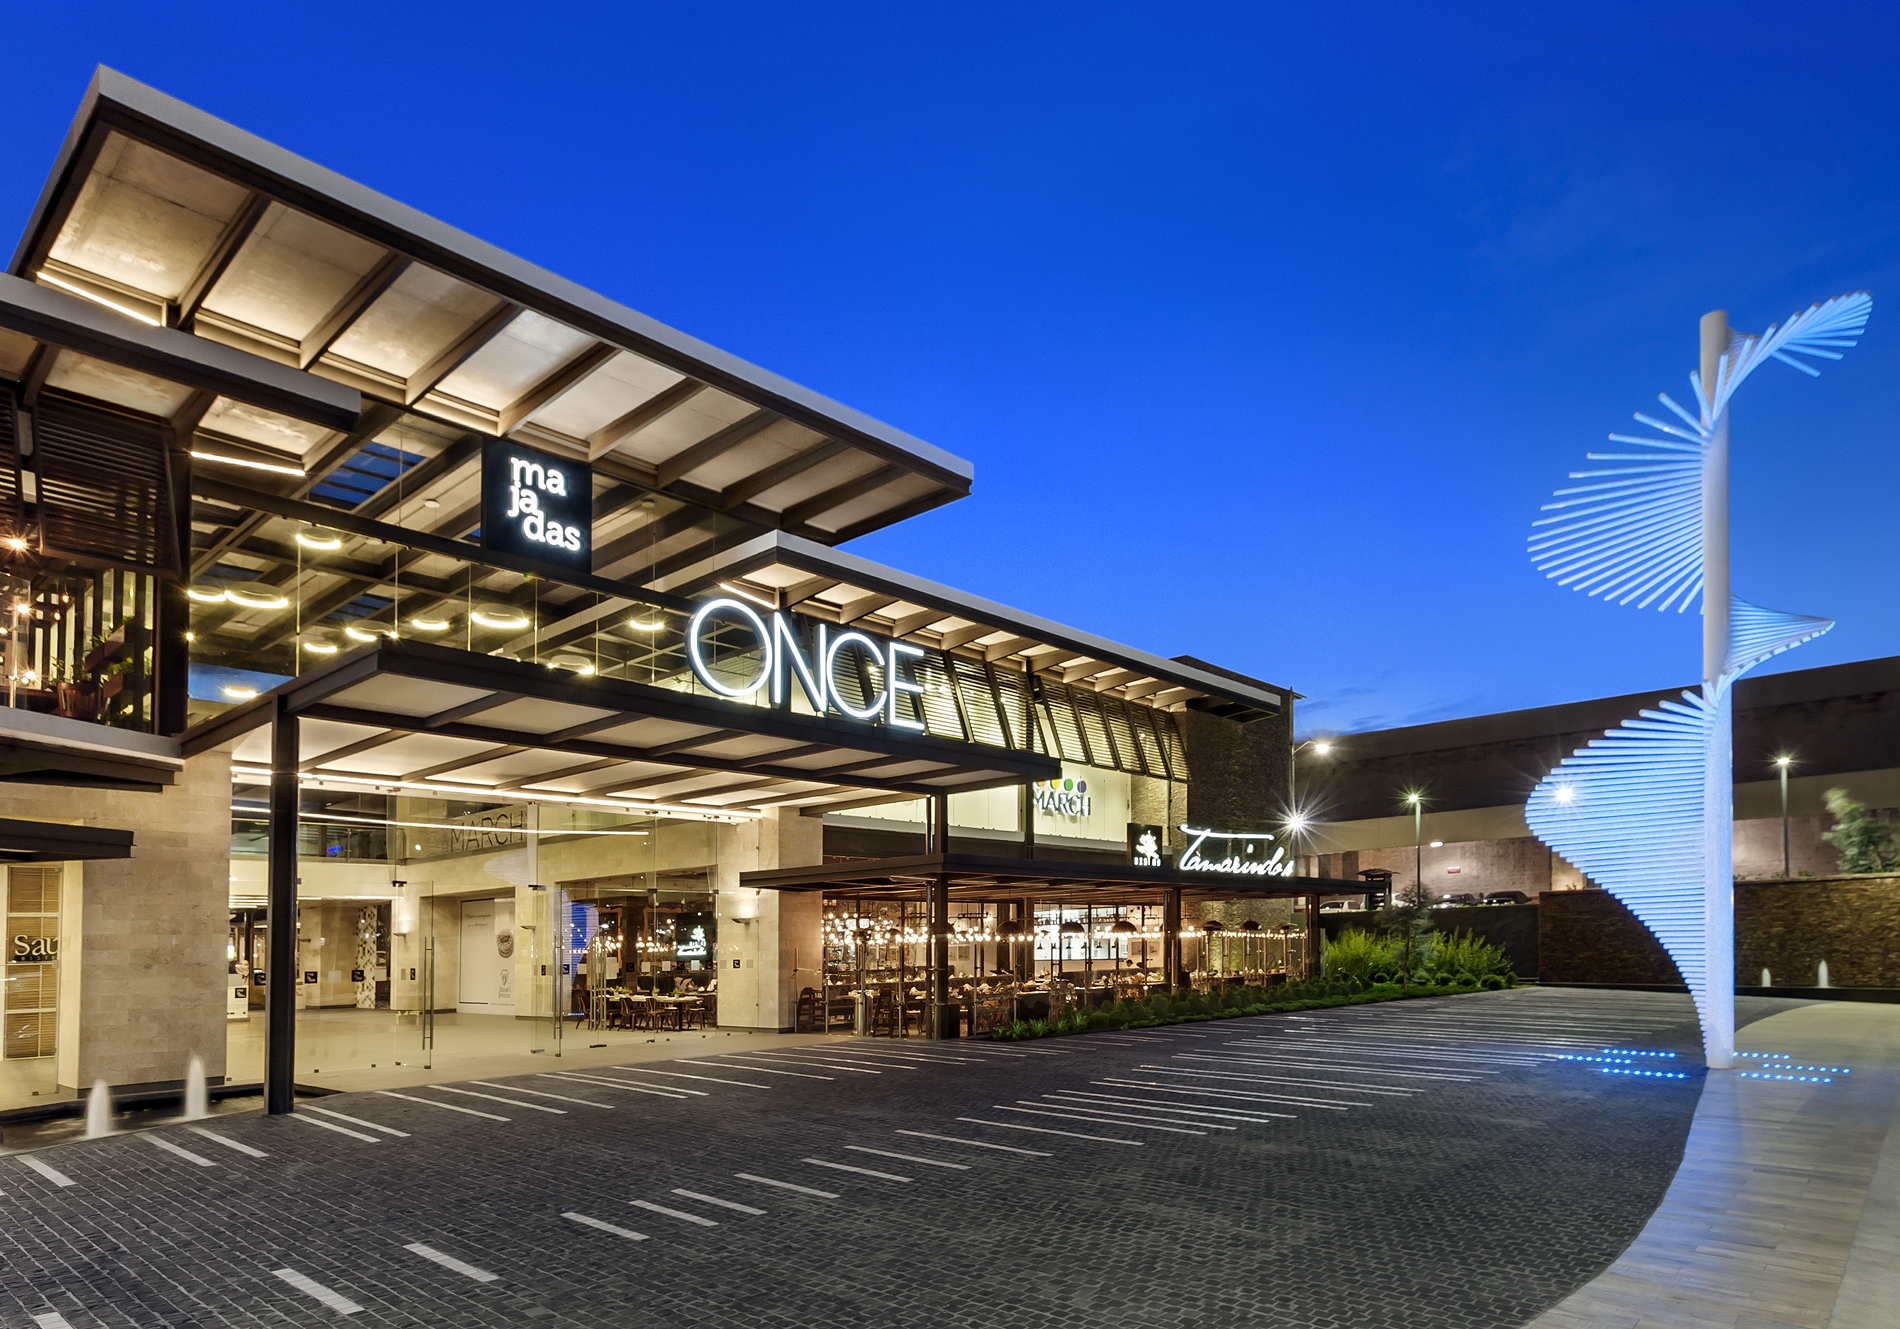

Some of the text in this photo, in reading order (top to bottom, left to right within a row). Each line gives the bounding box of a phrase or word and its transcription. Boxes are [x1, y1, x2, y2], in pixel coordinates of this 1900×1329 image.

[687, 598, 925, 730] ONCE
[1032, 790, 1091, 817] MARCH
[451, 811, 524, 852] MARCH
